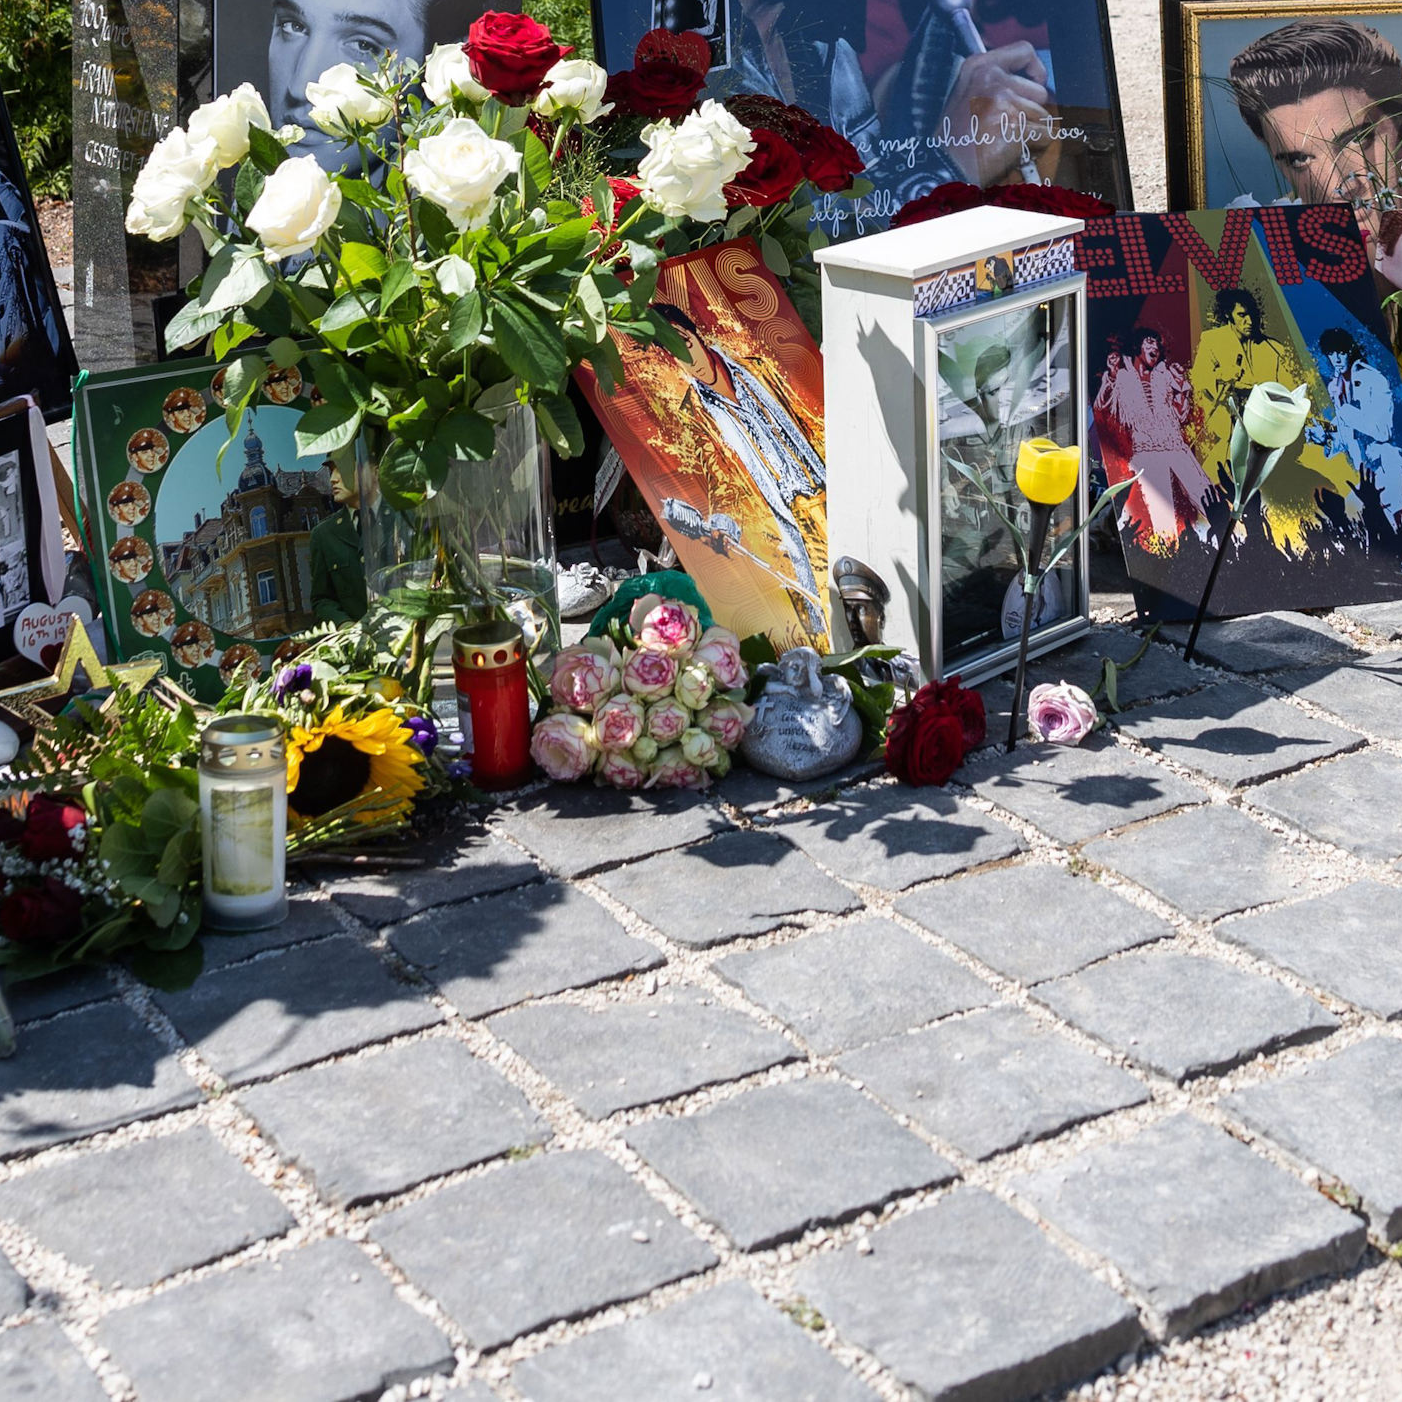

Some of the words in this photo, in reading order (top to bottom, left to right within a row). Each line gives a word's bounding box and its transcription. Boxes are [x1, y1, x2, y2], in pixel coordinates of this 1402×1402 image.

[79, 60, 122, 98] FRANK
[879, 136, 918, 168] my
[926, 116, 995, 149] whole
[1000, 110, 1041, 161] life
[1040, 114, 1087, 142] too,
[809, 194, 852, 238] elp
[1075, 205, 1367, 299] ELVIS
[21, 611, 73, 632] AUGUST
